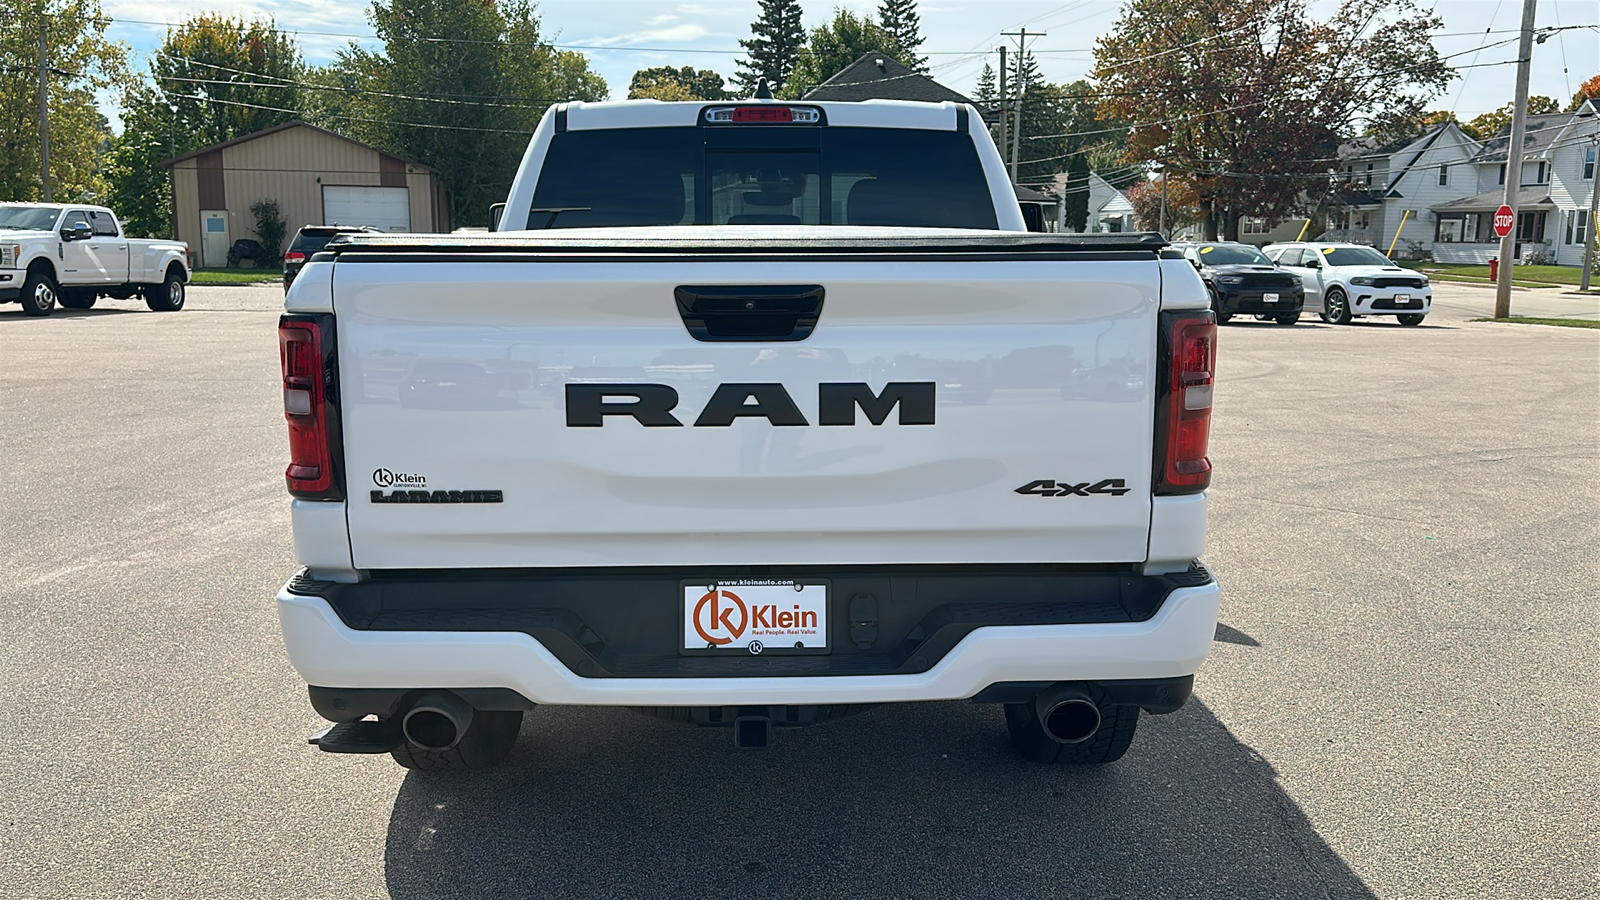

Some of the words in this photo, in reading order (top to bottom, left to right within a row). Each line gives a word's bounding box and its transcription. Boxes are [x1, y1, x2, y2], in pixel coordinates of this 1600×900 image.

[1495, 215, 1513, 227] STOP
[565, 382, 936, 427] RAM
[395, 473, 426, 483] Klein
[370, 490, 504, 503] LARAMIE
[752, 605, 817, 628] Klein
